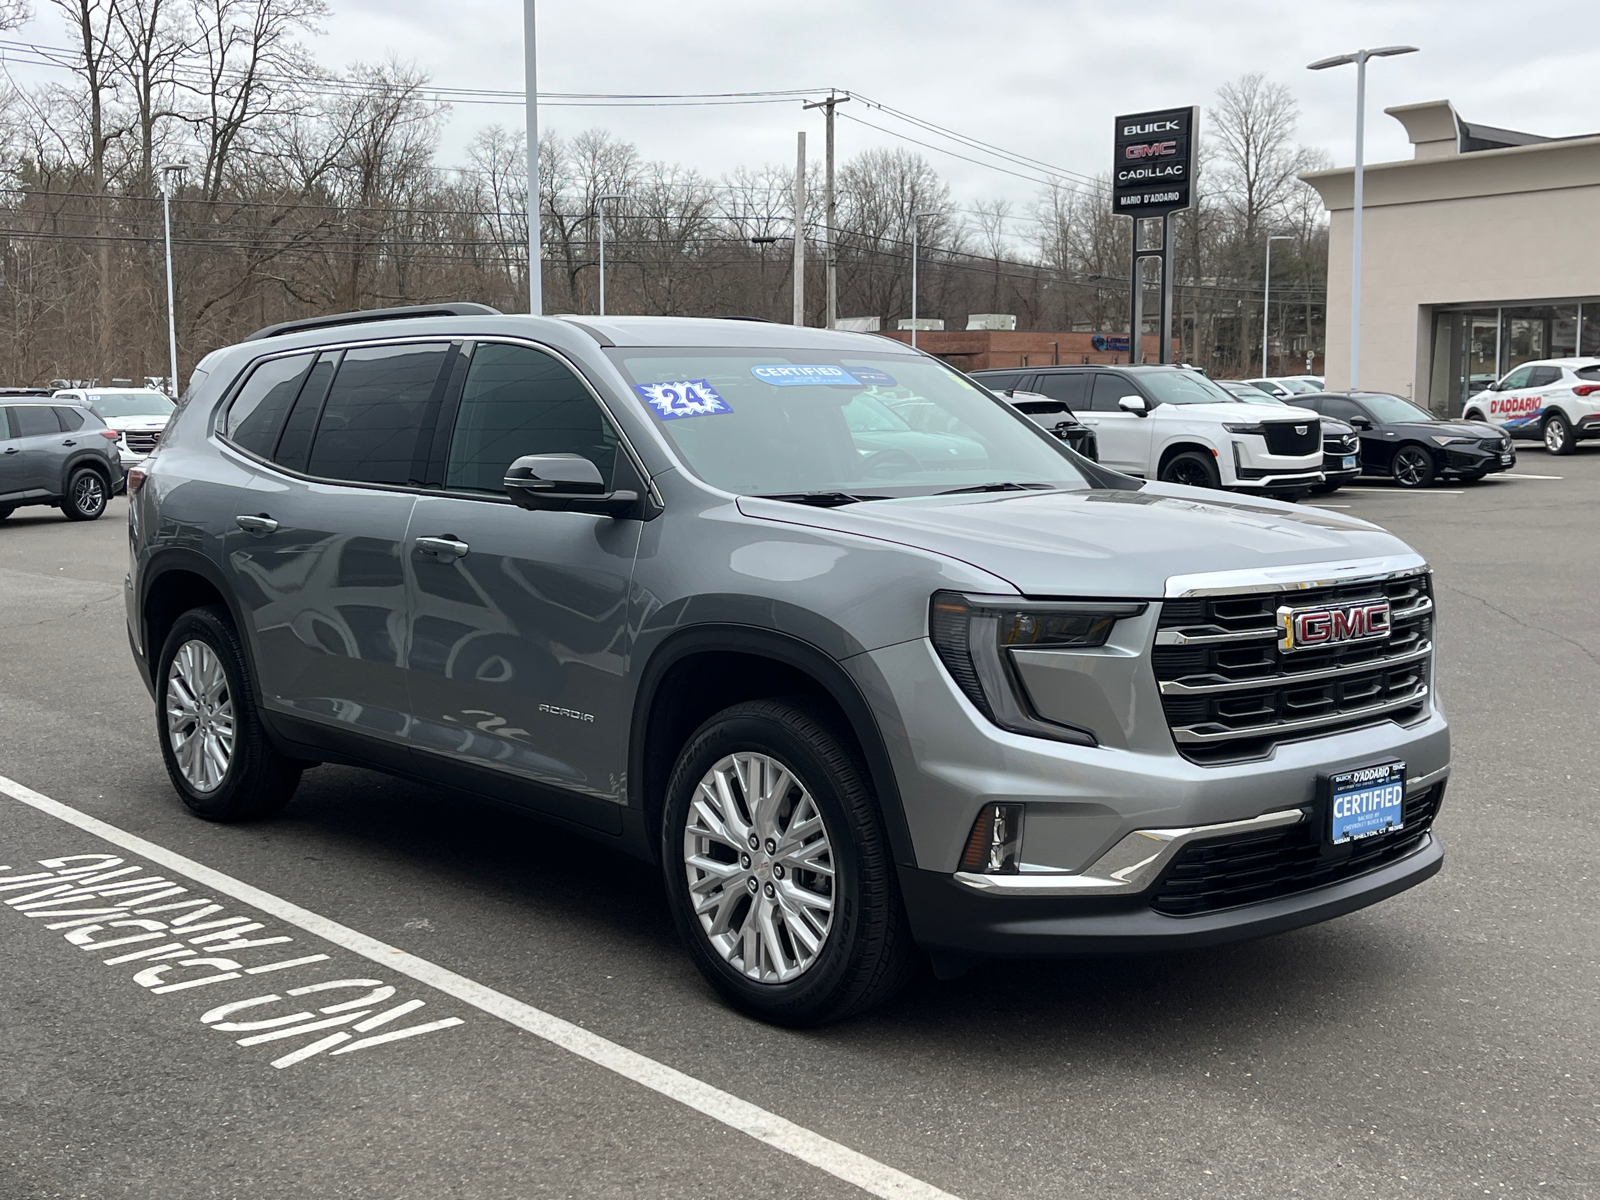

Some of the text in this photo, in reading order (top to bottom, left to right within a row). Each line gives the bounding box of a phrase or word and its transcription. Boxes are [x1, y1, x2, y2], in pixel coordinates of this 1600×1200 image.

[1124, 120, 1180, 136] BUICK
[1126, 141, 1177, 159] GMC
[1119, 166, 1183, 180] CADILLAC
[1121, 192, 1180, 206] MARIO D'ADDARIO
[755, 367, 843, 378] CERTIFIED
[661, 386, 706, 410] 24
[1490, 396, 1542, 414] D'ADDARIO
[1297, 604, 1390, 644] GMC
[538, 703, 595, 723] ACADIA
[1354, 767, 1389, 782] D'ADDARIO
[1333, 786, 1403, 818] CERTIFIED
[0, 853, 466, 1069] NO PARKING
